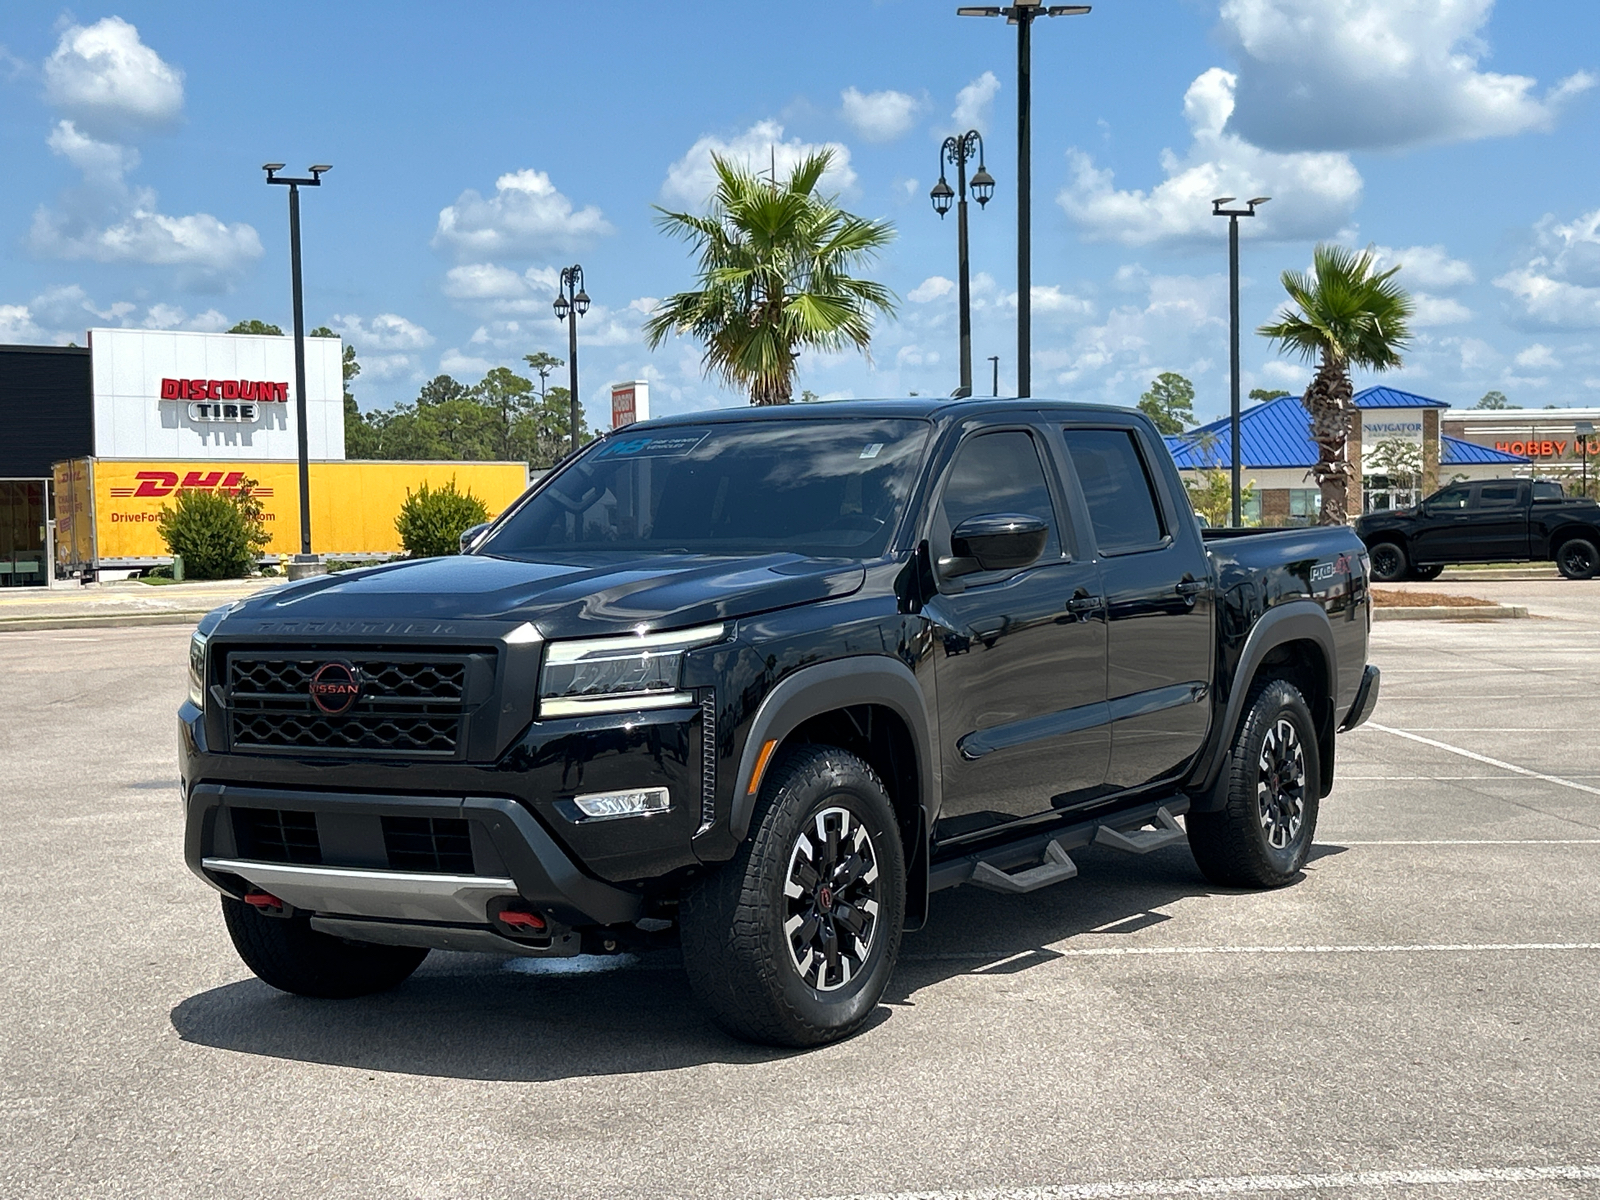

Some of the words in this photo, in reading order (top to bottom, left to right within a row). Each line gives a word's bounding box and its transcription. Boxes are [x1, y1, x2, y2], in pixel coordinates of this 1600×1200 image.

[161, 378, 288, 402] DISCOUNT
[197, 404, 254, 418] TIRE
[1363, 423, 1422, 432] NAVIGATOR
[1495, 440, 1567, 456] HOBBY
[133, 471, 252, 497] DHL
[258, 621, 457, 634] FRONTIER
[309, 684, 359, 694] NISSAN
